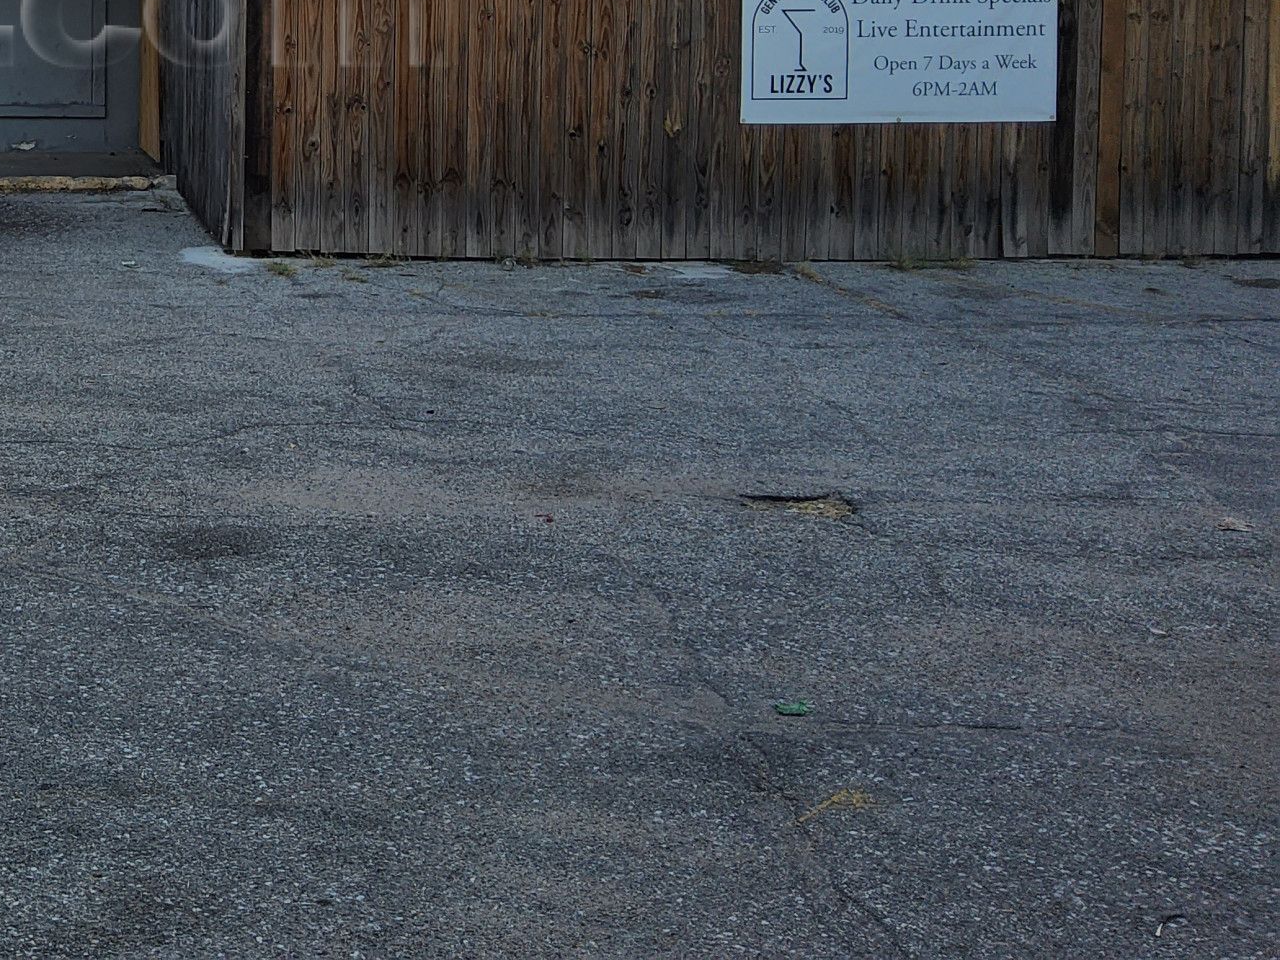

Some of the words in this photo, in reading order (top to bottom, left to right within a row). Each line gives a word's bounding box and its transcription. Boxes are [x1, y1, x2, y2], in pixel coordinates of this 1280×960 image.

[758, 25, 777, 34] EST
[823, 26, 845, 35] 2019
[856, 19, 898, 39] Live
[905, 19, 1046, 39] Entertainment
[873, 54, 918, 74] Open
[923, 55, 933, 71] 7
[938, 54, 977, 74] Days
[981, 60, 990, 70] a
[994, 53, 1038, 70] Week
[770, 74, 833, 94] LIZZY'S
[912, 80, 998, 96] 6PM-2AM
